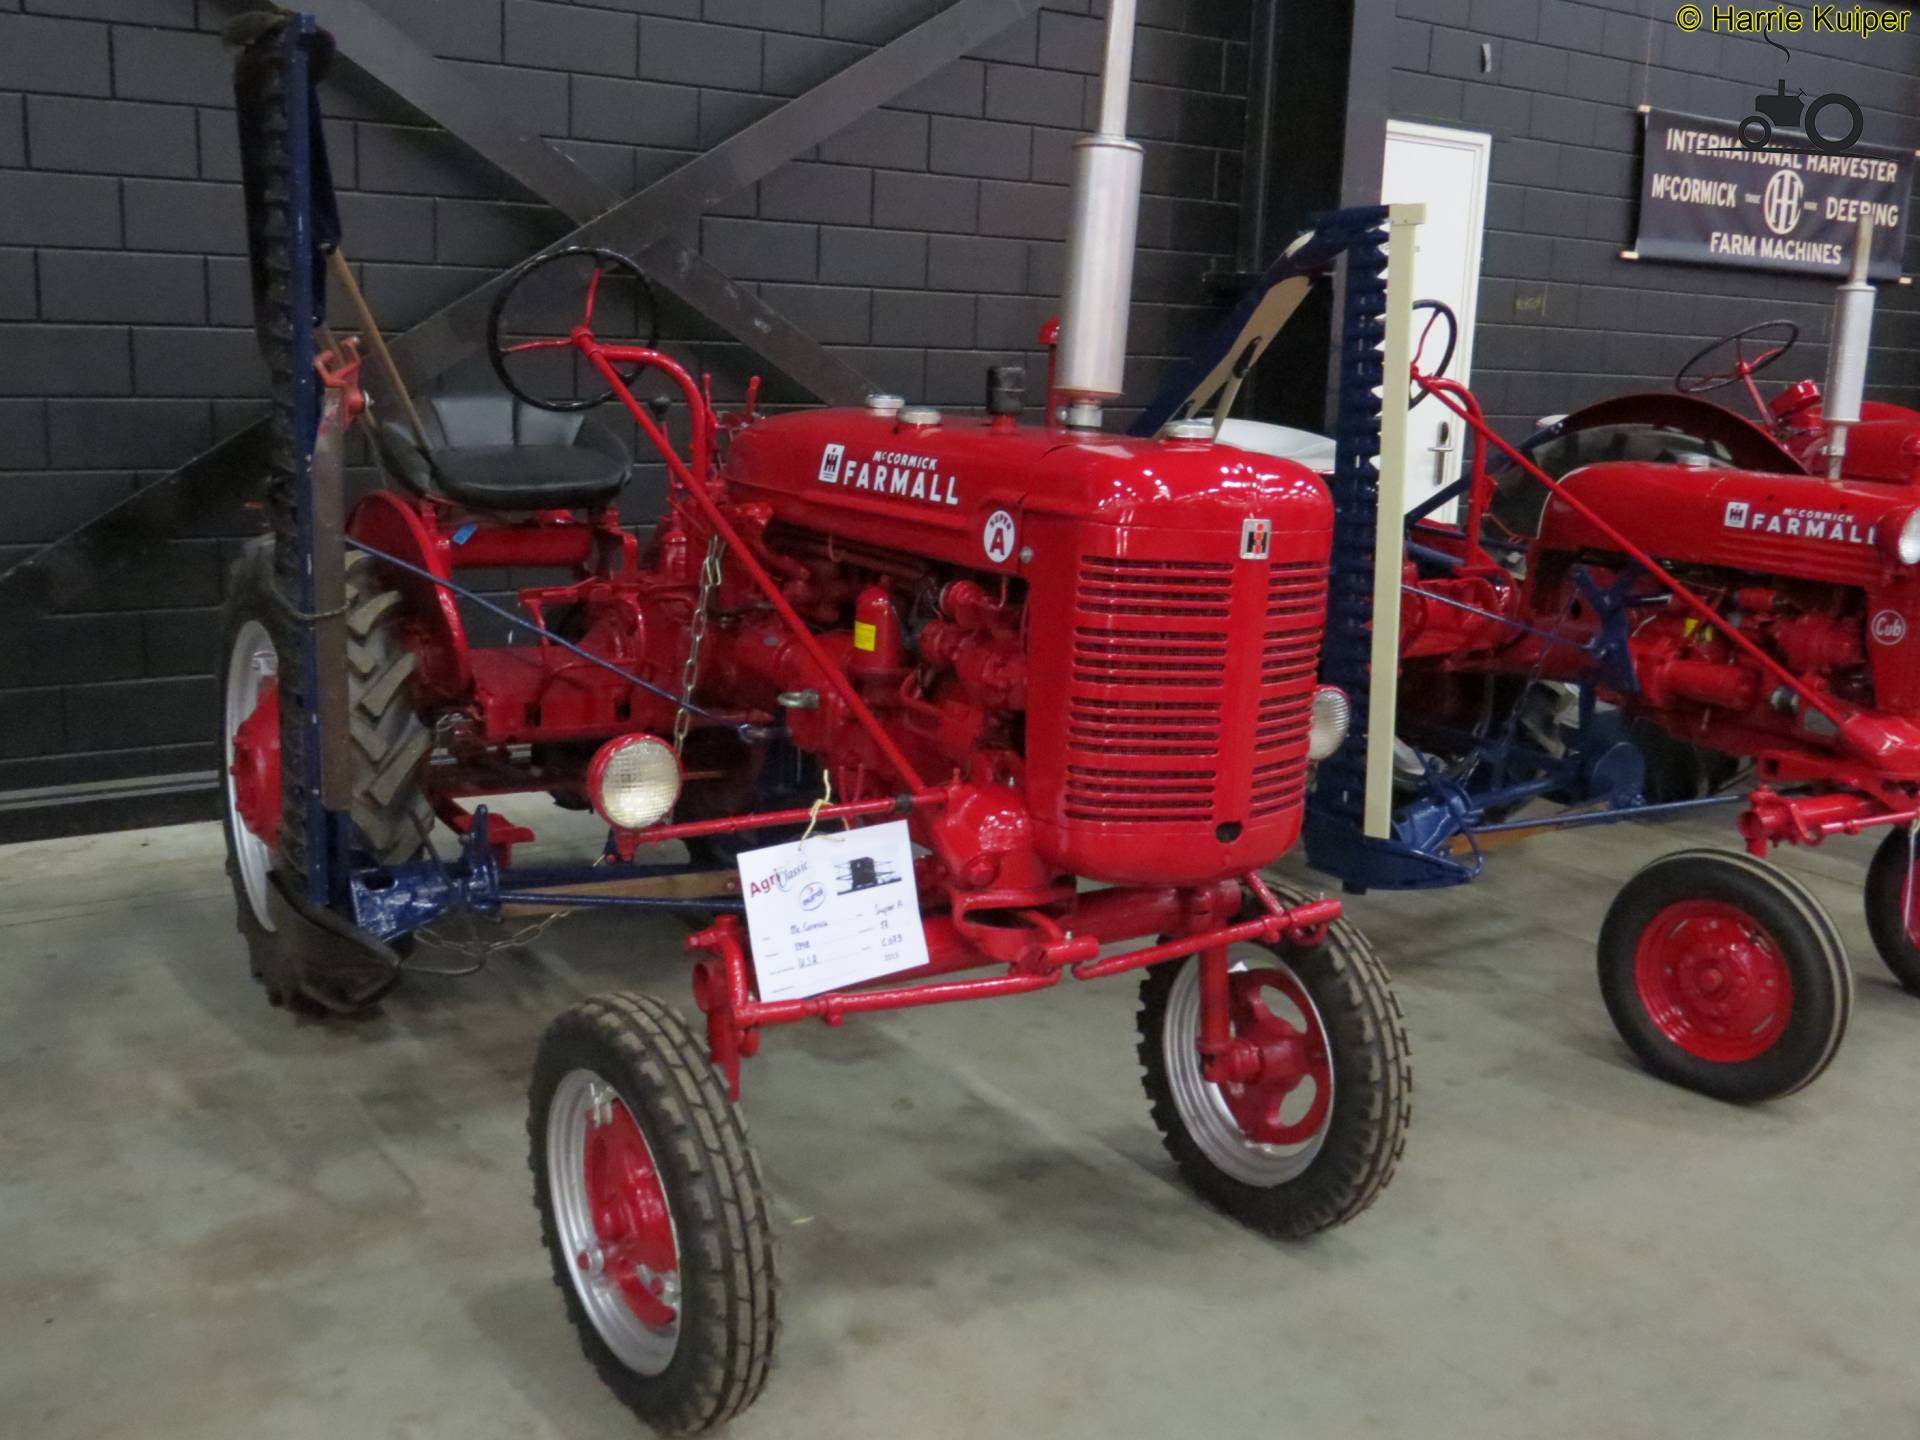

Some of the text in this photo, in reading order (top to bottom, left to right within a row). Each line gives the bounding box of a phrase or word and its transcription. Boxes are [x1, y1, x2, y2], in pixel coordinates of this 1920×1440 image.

[1805, 154, 1898, 182] HARVESTER
[1710, 231, 1842, 265] FARM MACHINES
[843, 460, 959, 505] FARMALL
[990, 526, 1005, 556] A
[1876, 616, 1902, 637] Cub
[750, 868, 780, 898] Agri
